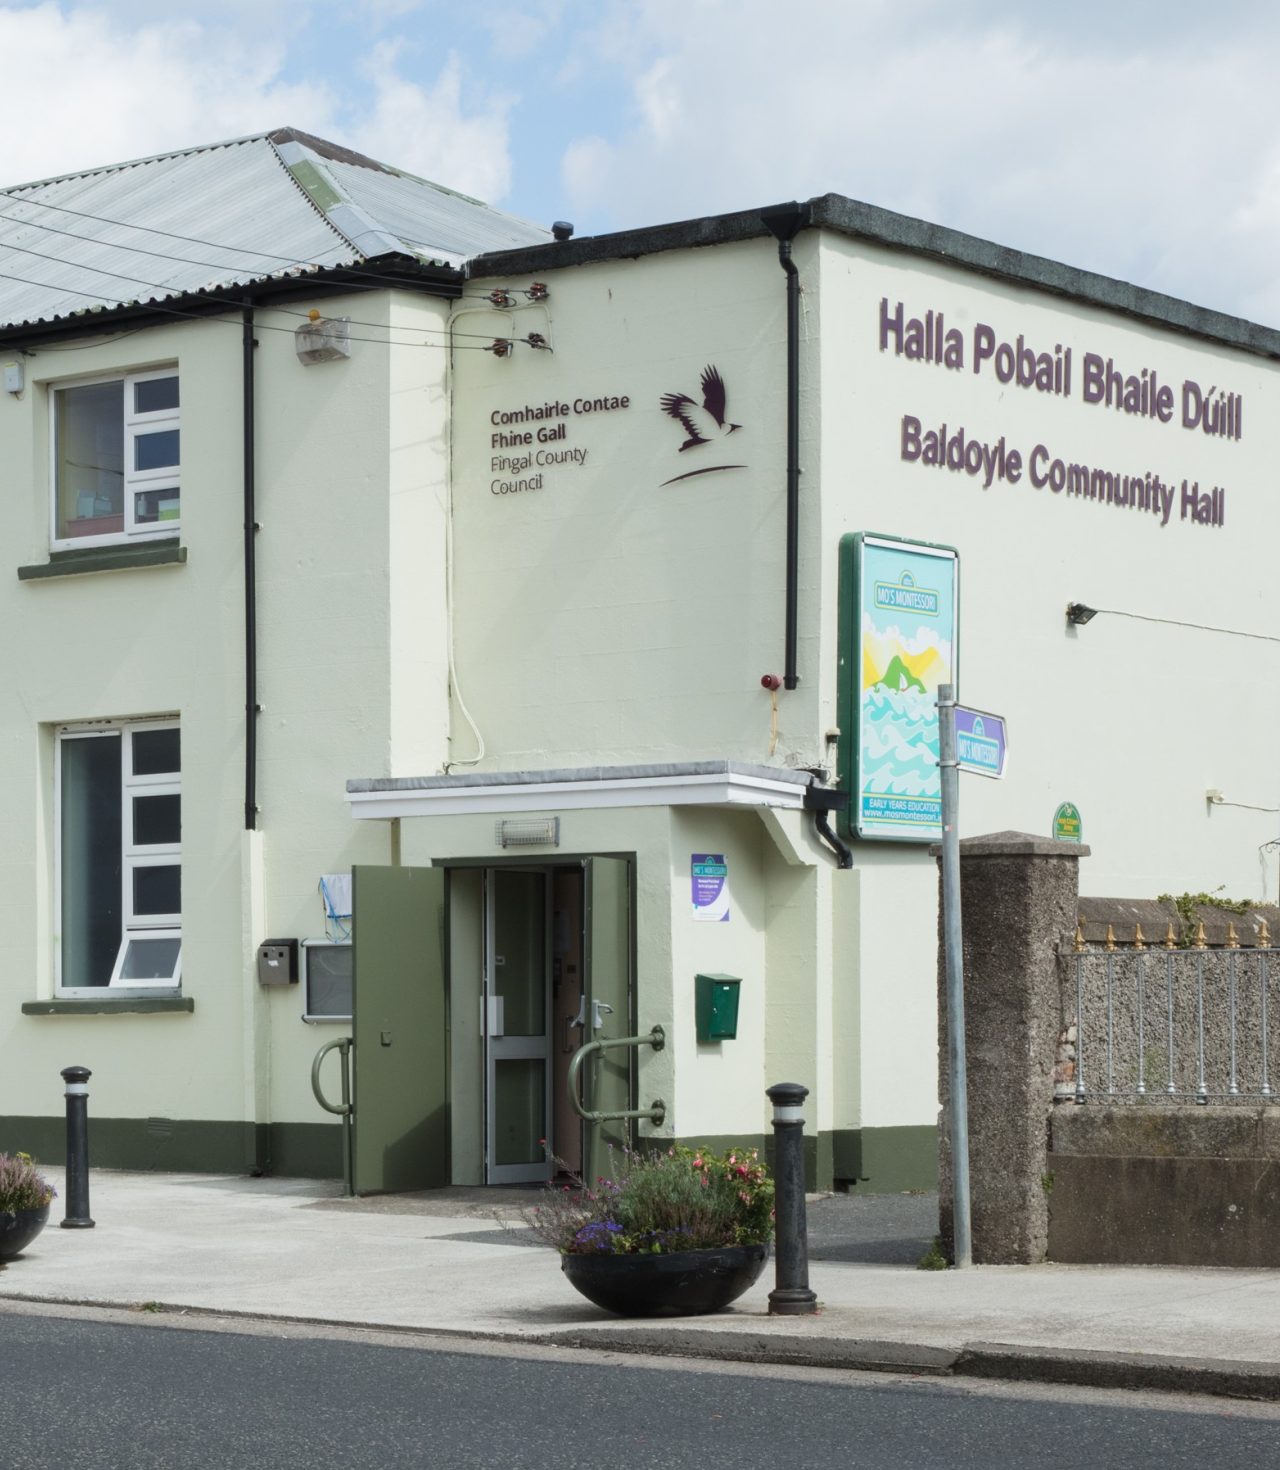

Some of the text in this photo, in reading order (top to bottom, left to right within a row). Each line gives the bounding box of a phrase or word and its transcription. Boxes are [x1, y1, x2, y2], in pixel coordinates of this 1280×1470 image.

[879, 297, 1243, 440] Halla Pobail Bhaile Dúill
[491, 395, 630, 426] Comhairle Contae
[491, 424, 567, 449] Fhine Gall
[491, 447, 588, 474] Fingal County
[901, 415, 1225, 527] Baldoyle Community Hall
[491, 473, 543, 496] Council
[863, 809, 941, 822] www.mosmontessori.i
[869, 798, 940, 812] EARLY YEARS EDUCATION
